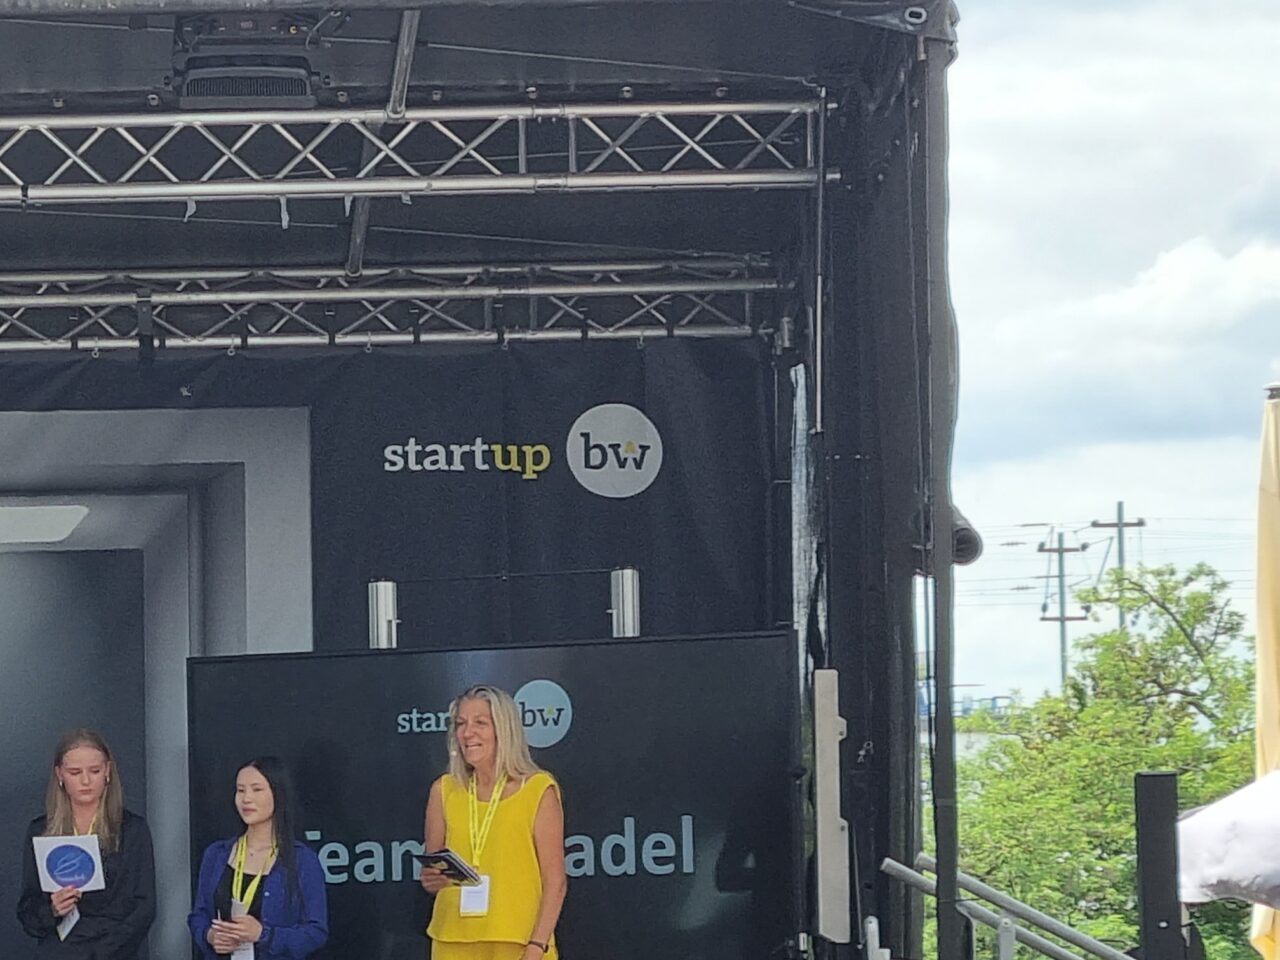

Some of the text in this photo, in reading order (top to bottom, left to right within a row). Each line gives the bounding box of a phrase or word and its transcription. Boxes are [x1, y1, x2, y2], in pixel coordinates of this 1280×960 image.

[383, 432, 651, 479] startup bw
[397, 702, 564, 733] star bw
[305, 814, 695, 883] eam adel
